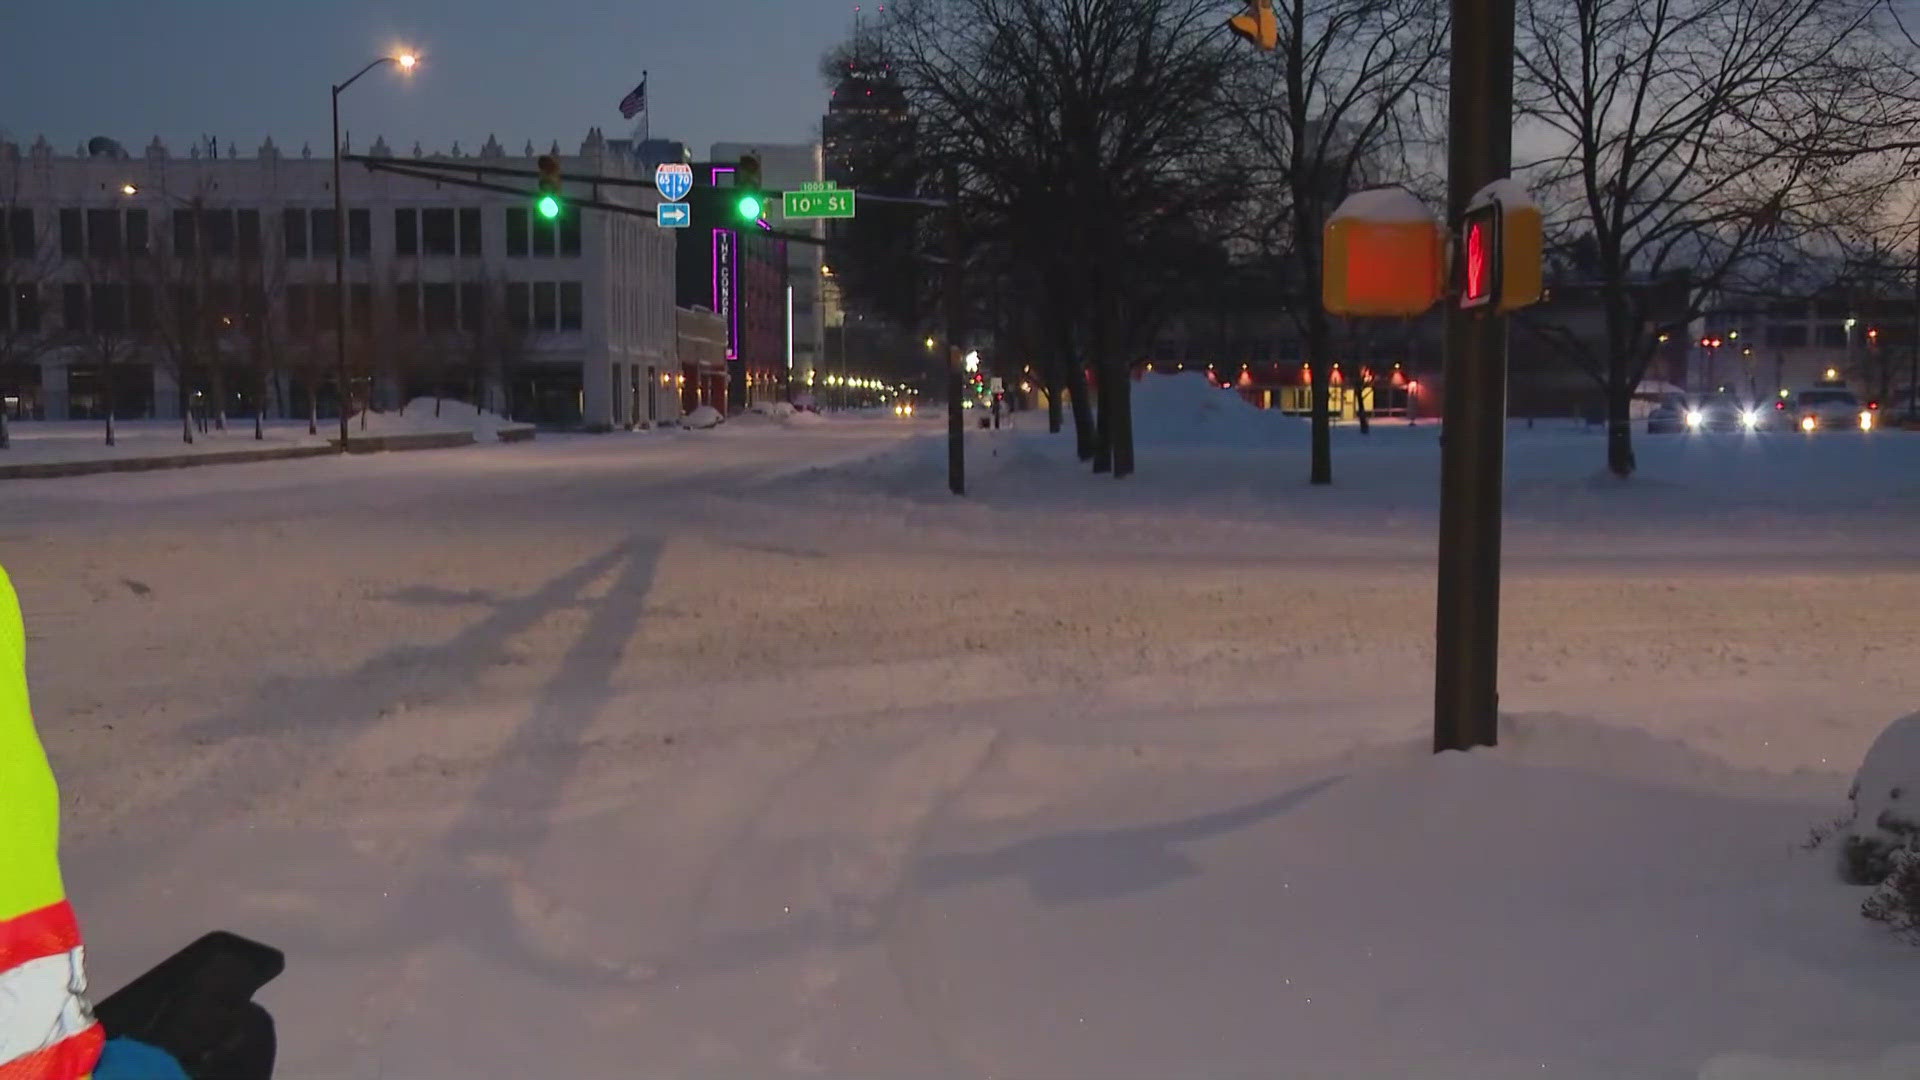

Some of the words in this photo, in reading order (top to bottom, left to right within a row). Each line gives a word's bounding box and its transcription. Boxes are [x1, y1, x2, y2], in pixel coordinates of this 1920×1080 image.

[659, 173, 670, 184] 65
[678, 173, 690, 184] 70
[804, 182, 824, 191] 1000
[792, 197, 822, 212] 10th
[828, 196, 846, 211] St
[721, 233, 729, 264] THE
